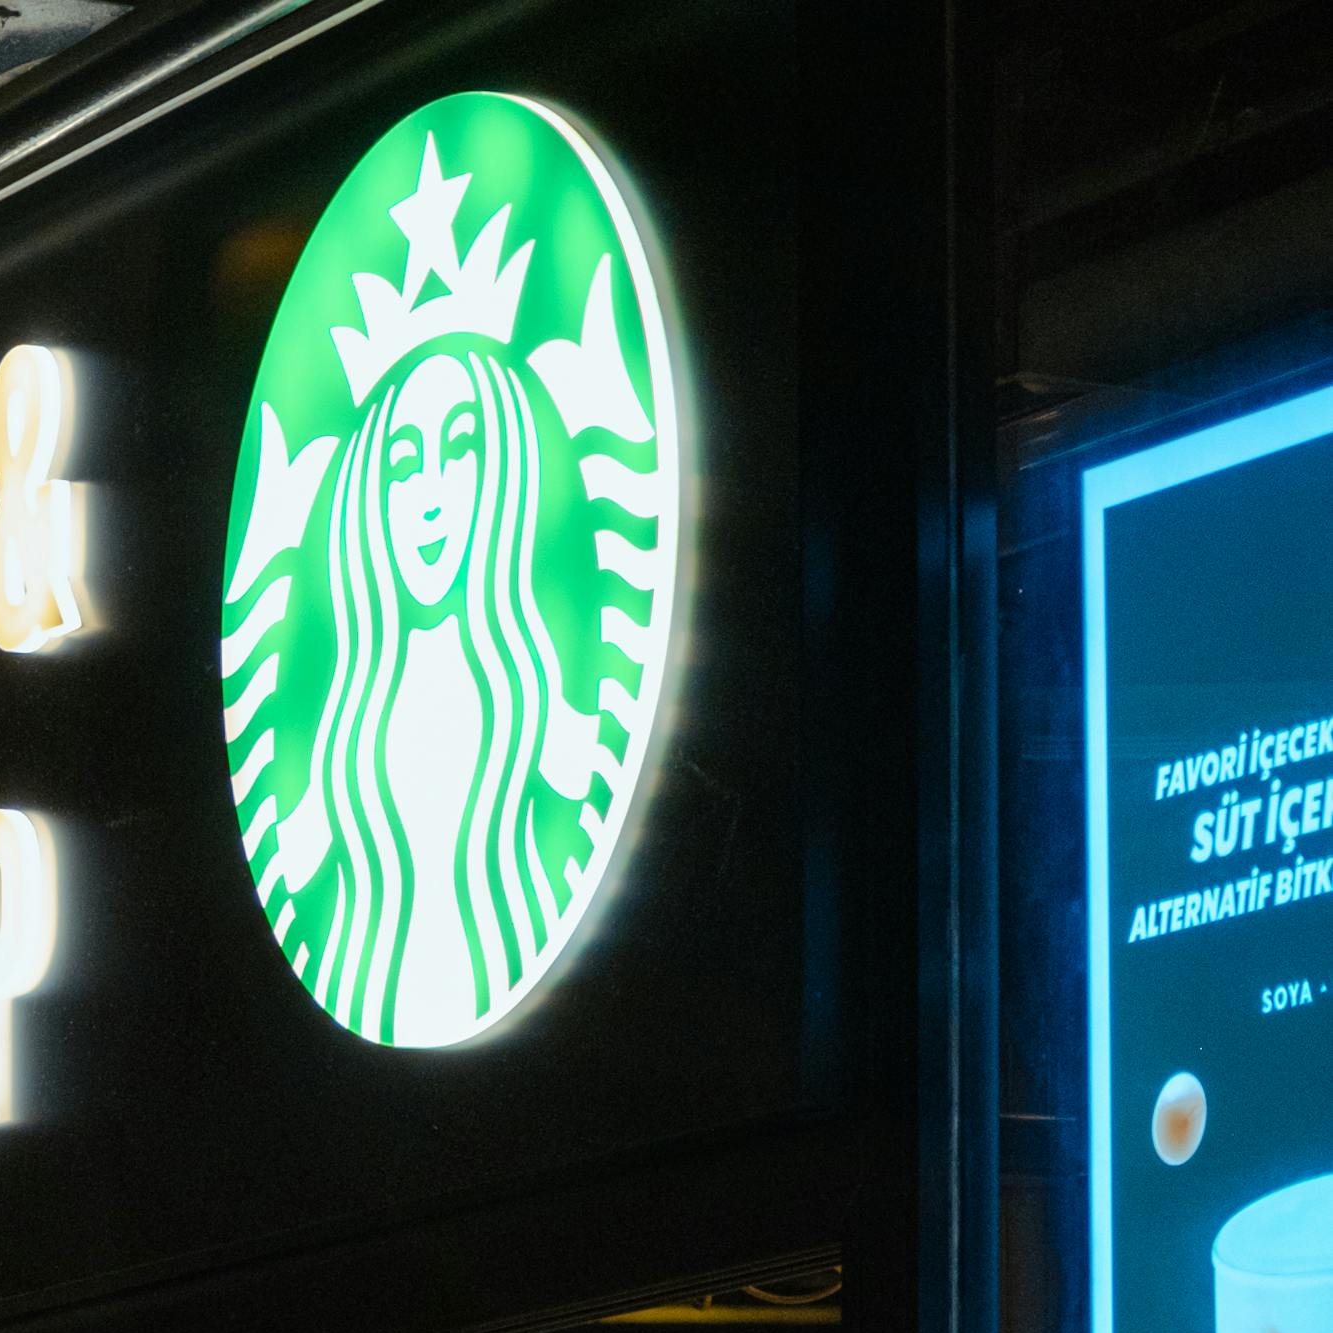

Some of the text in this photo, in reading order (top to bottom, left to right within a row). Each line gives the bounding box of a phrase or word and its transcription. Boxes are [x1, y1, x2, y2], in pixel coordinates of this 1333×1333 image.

[1154, 731, 1248, 801] FAVORİ
[1190, 789, 1263, 864] SÜT
[1128, 866, 1274, 944] ALTERNATİF
[1261, 978, 1314, 1015] SOYA
